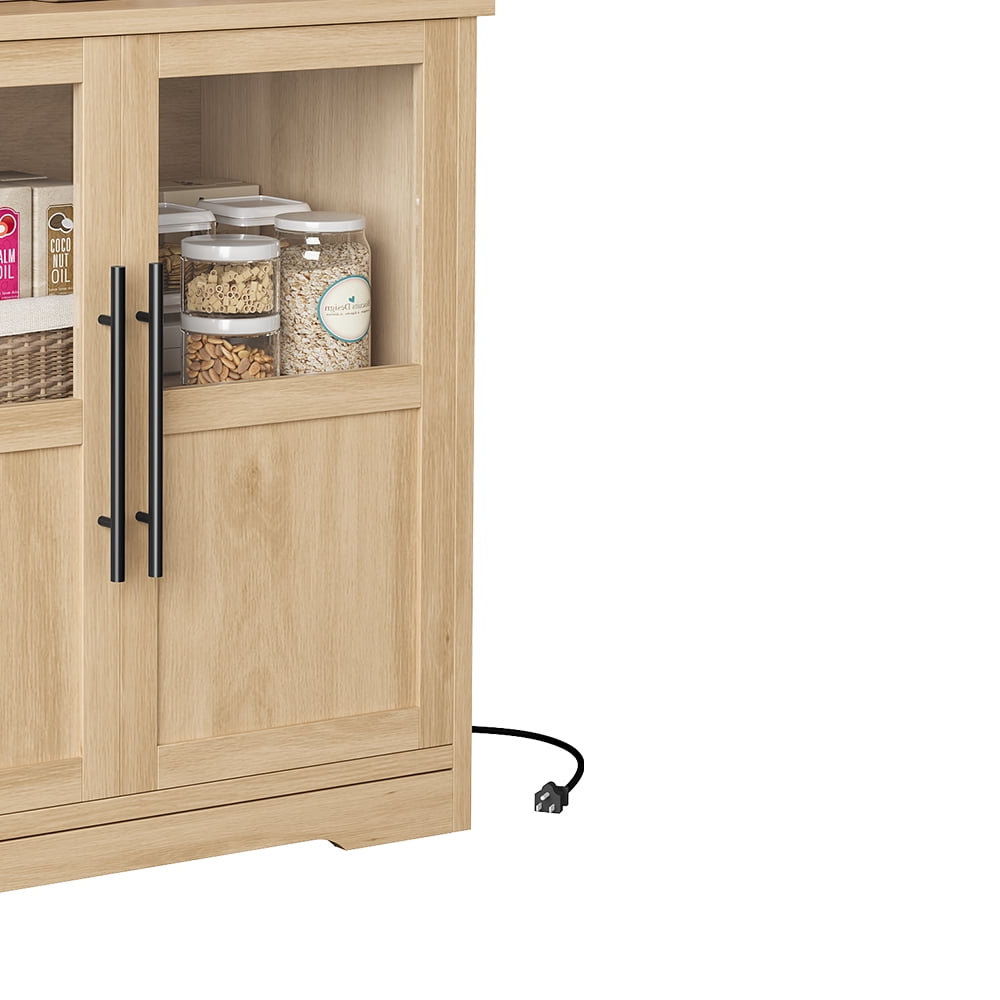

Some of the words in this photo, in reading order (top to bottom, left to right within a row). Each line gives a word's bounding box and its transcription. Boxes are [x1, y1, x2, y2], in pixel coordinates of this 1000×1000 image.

[50, 238, 71, 253] COCO
[53, 253, 69, 268] NUT
[51, 269, 70, 284] OIL
